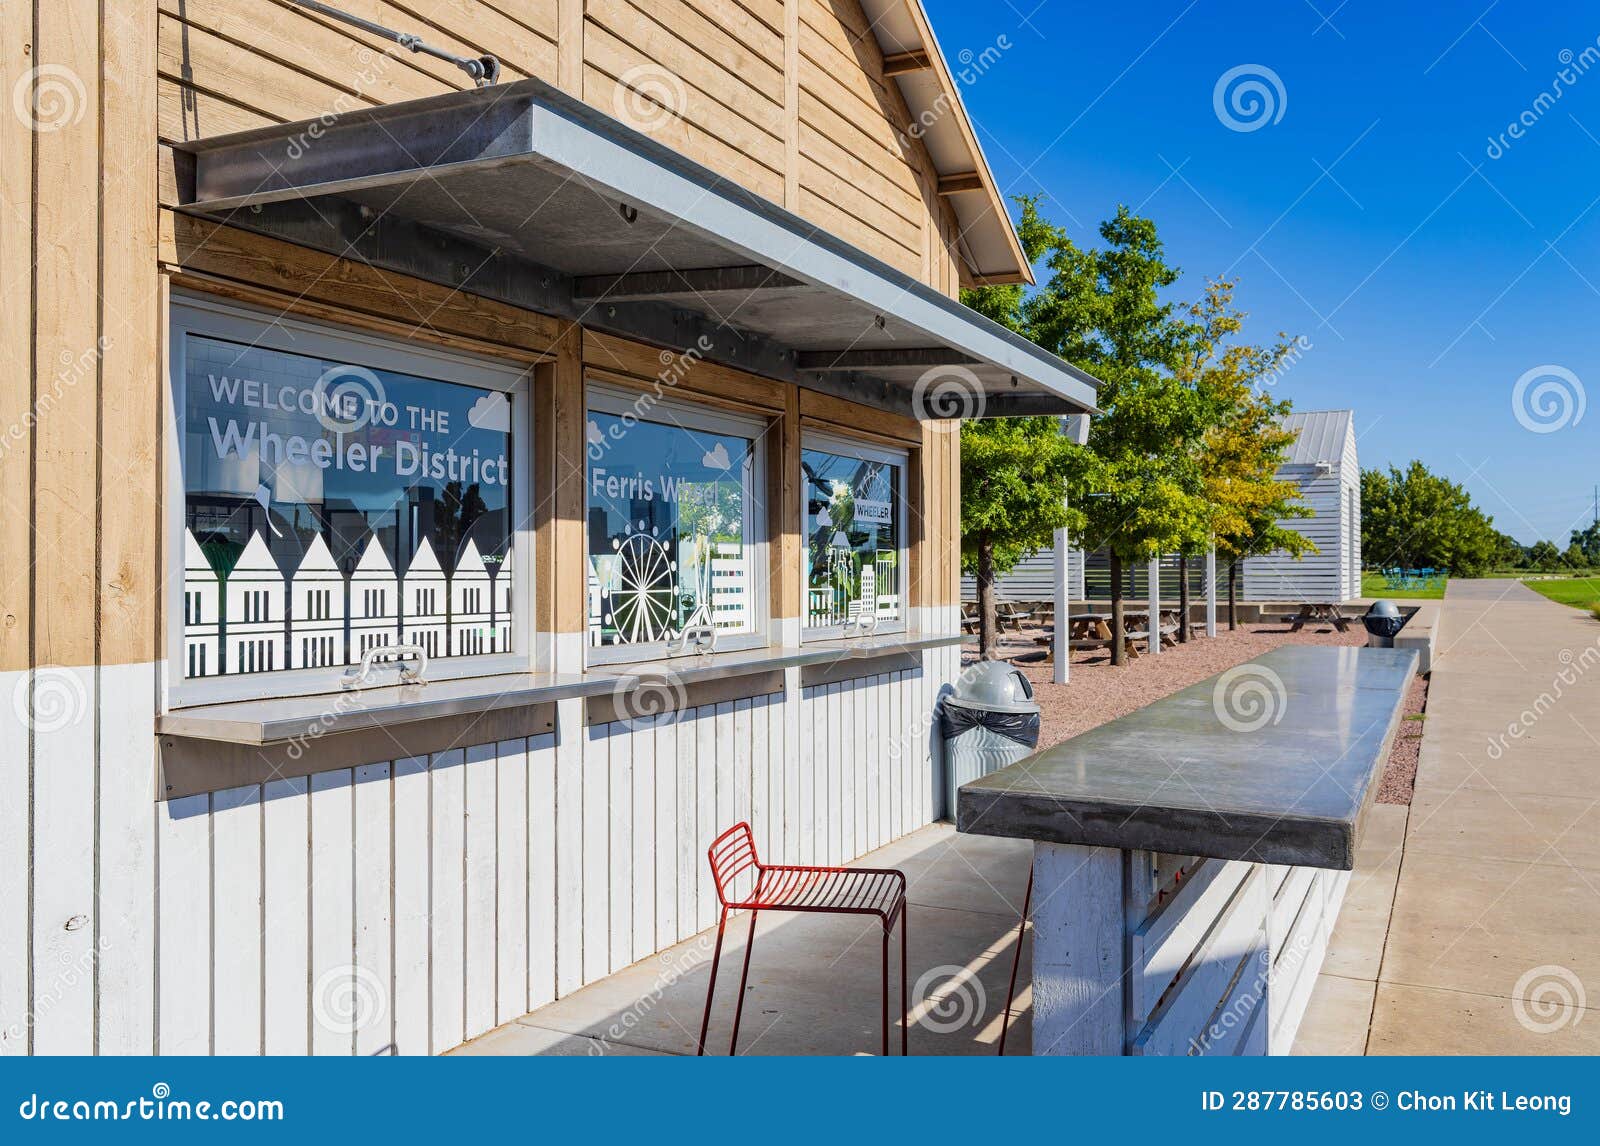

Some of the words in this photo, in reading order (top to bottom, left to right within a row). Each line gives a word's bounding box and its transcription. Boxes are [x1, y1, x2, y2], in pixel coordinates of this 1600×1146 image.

[208, 374, 357, 420] WELCOME
[366, 400, 399, 426] TO
[407, 405, 449, 434] THE
[208, 416, 383, 473] Wheeler
[396, 440, 508, 486] District
[592, 467, 653, 501] Ferris
[660, 475, 718, 506] Wheel
[857, 503, 889, 519] WHEELER
